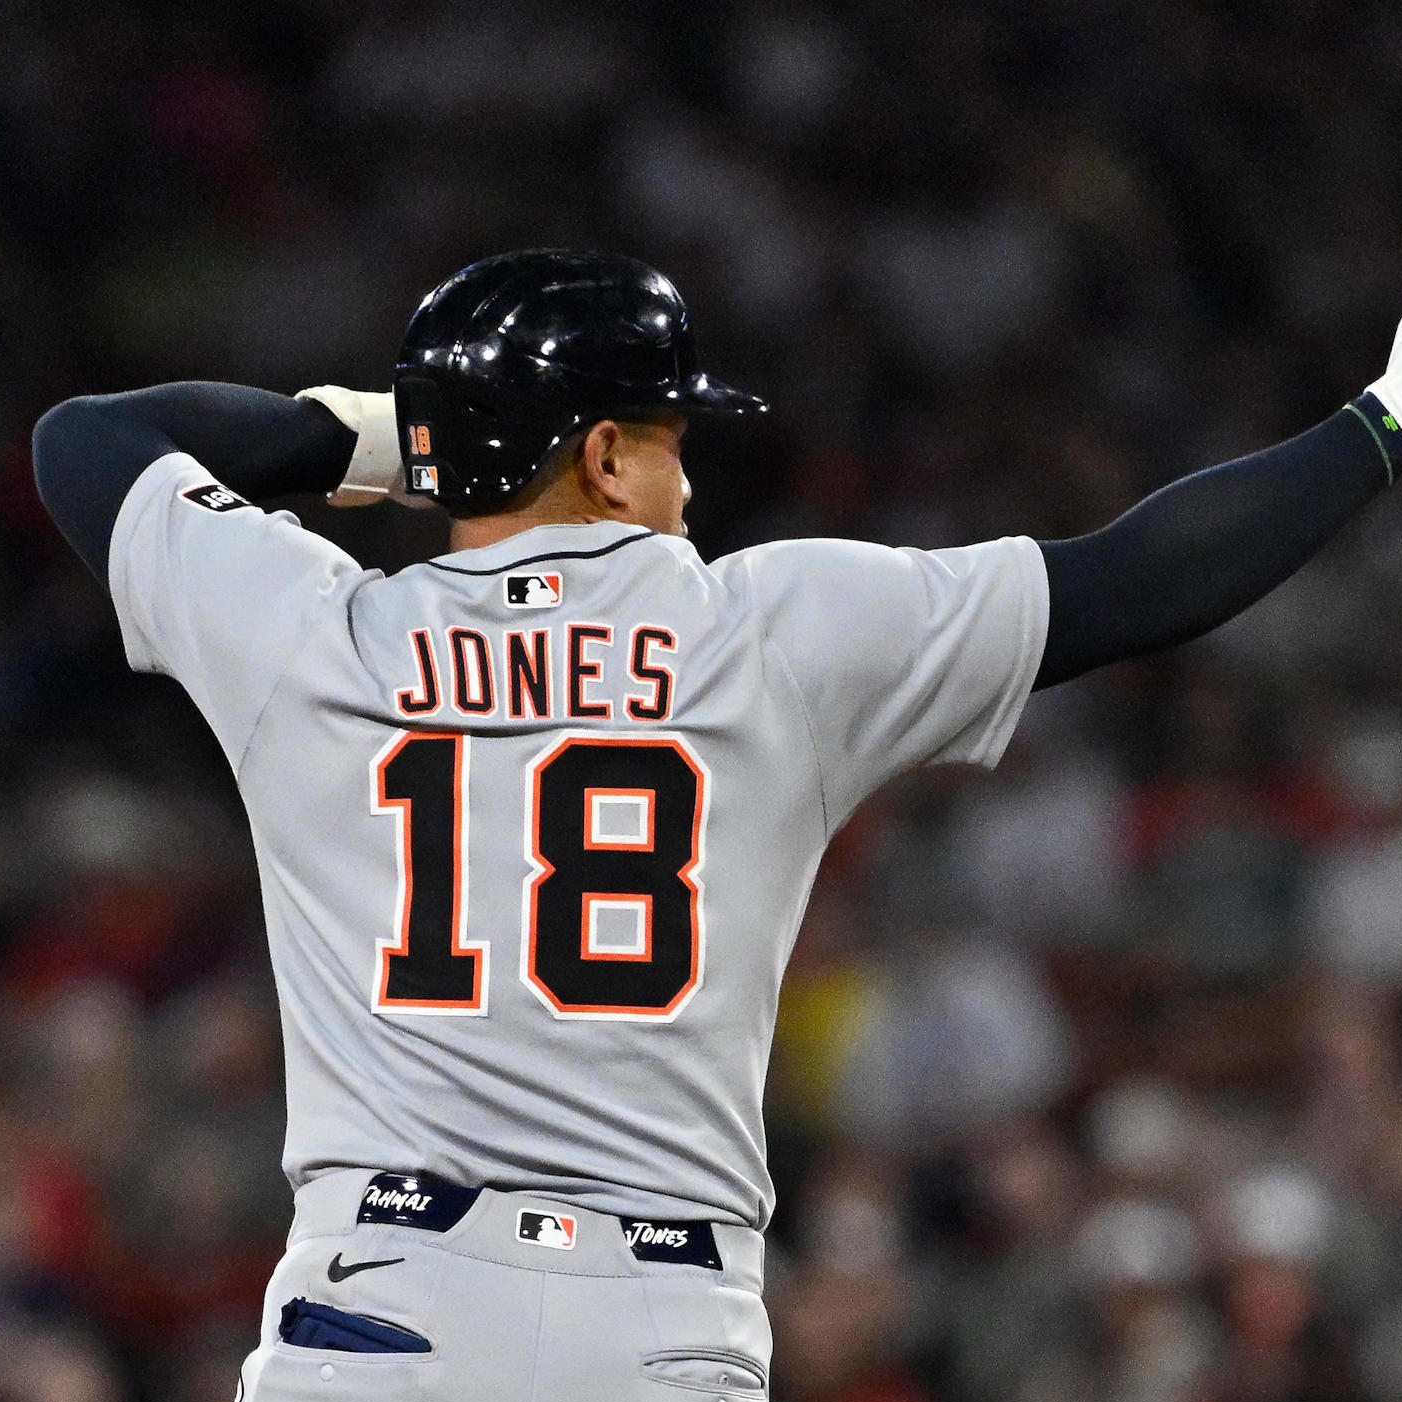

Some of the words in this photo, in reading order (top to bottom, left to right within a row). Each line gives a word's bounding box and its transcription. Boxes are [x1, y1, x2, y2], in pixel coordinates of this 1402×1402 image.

[408, 425, 432, 455] 18
[394, 622, 679, 721] JONES
[369, 728, 711, 1023] 18
[625, 1222, 688, 1248] JONES
